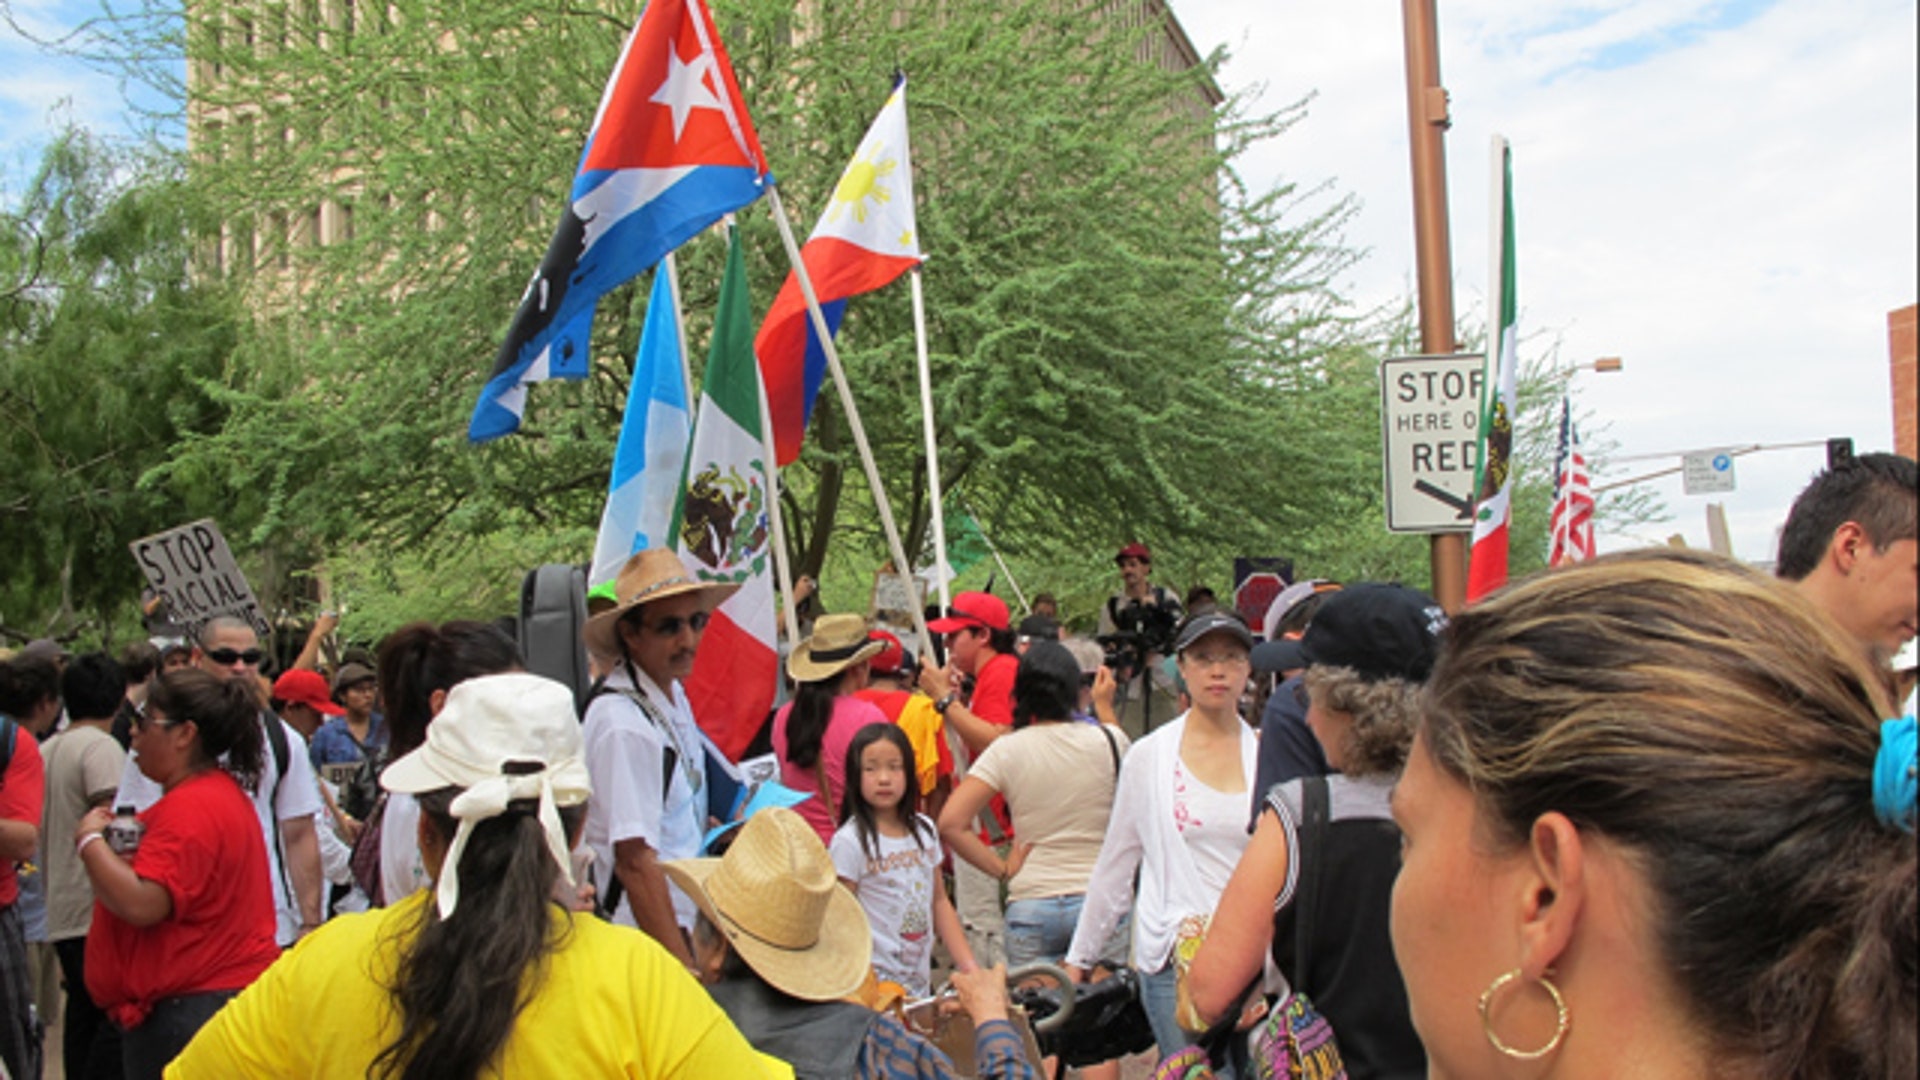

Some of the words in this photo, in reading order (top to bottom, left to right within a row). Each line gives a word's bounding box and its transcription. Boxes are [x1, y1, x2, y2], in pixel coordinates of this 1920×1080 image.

[1397, 412, 1453, 433] HERE
[1463, 410, 1478, 430] O
[139, 525, 217, 585] STOP
